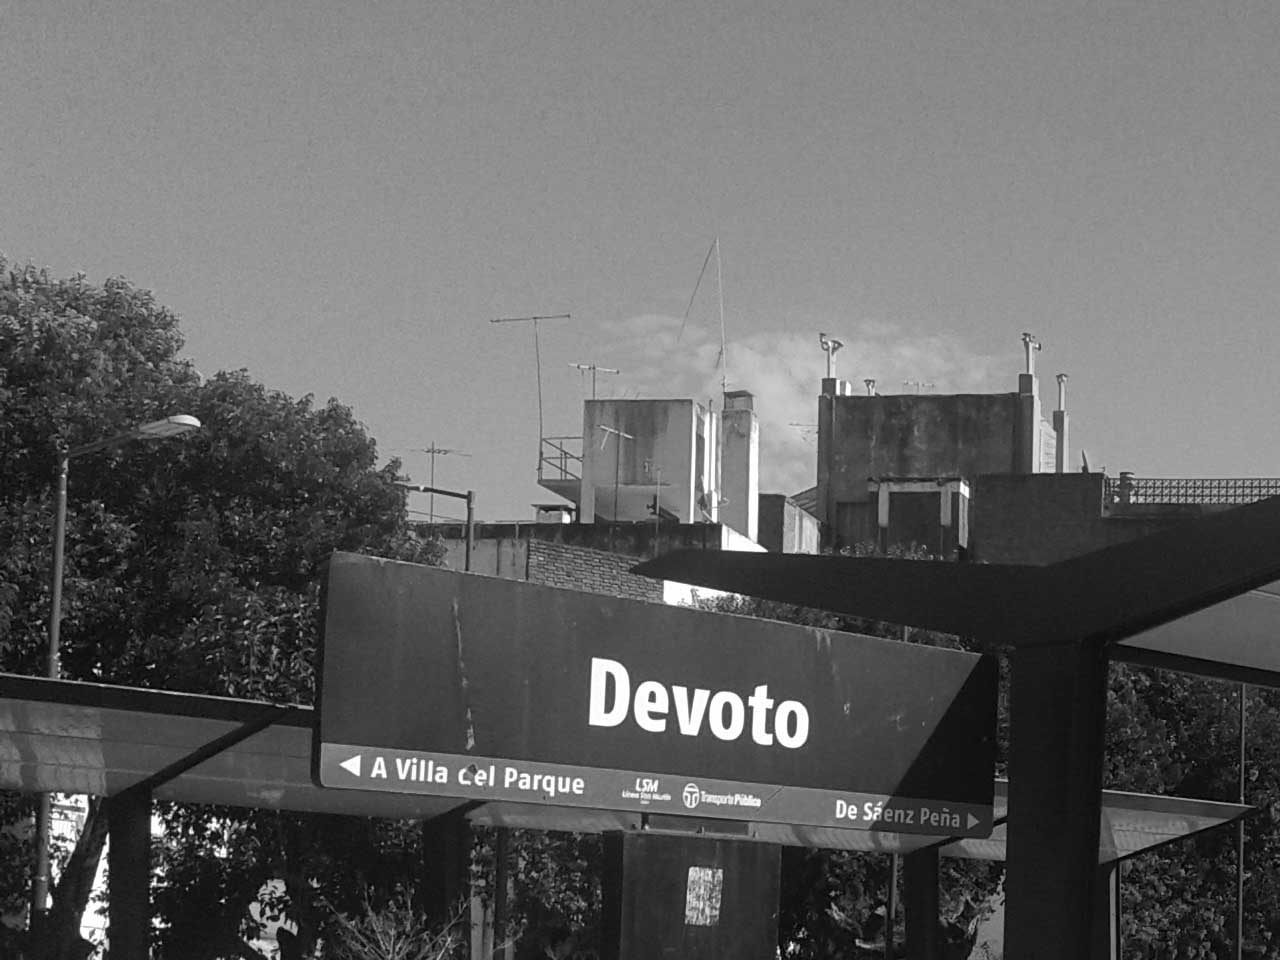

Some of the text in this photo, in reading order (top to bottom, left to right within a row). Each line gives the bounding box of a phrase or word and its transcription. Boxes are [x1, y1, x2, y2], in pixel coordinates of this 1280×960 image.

[588, 657, 809, 749] Devoto
[370, 757, 387, 779] A
[396, 758, 448, 783] Villa
[504, 767, 585, 797] Parque
[635, 778, 659, 792] LSM
[835, 799, 960, 828] De Sáenz Peña
